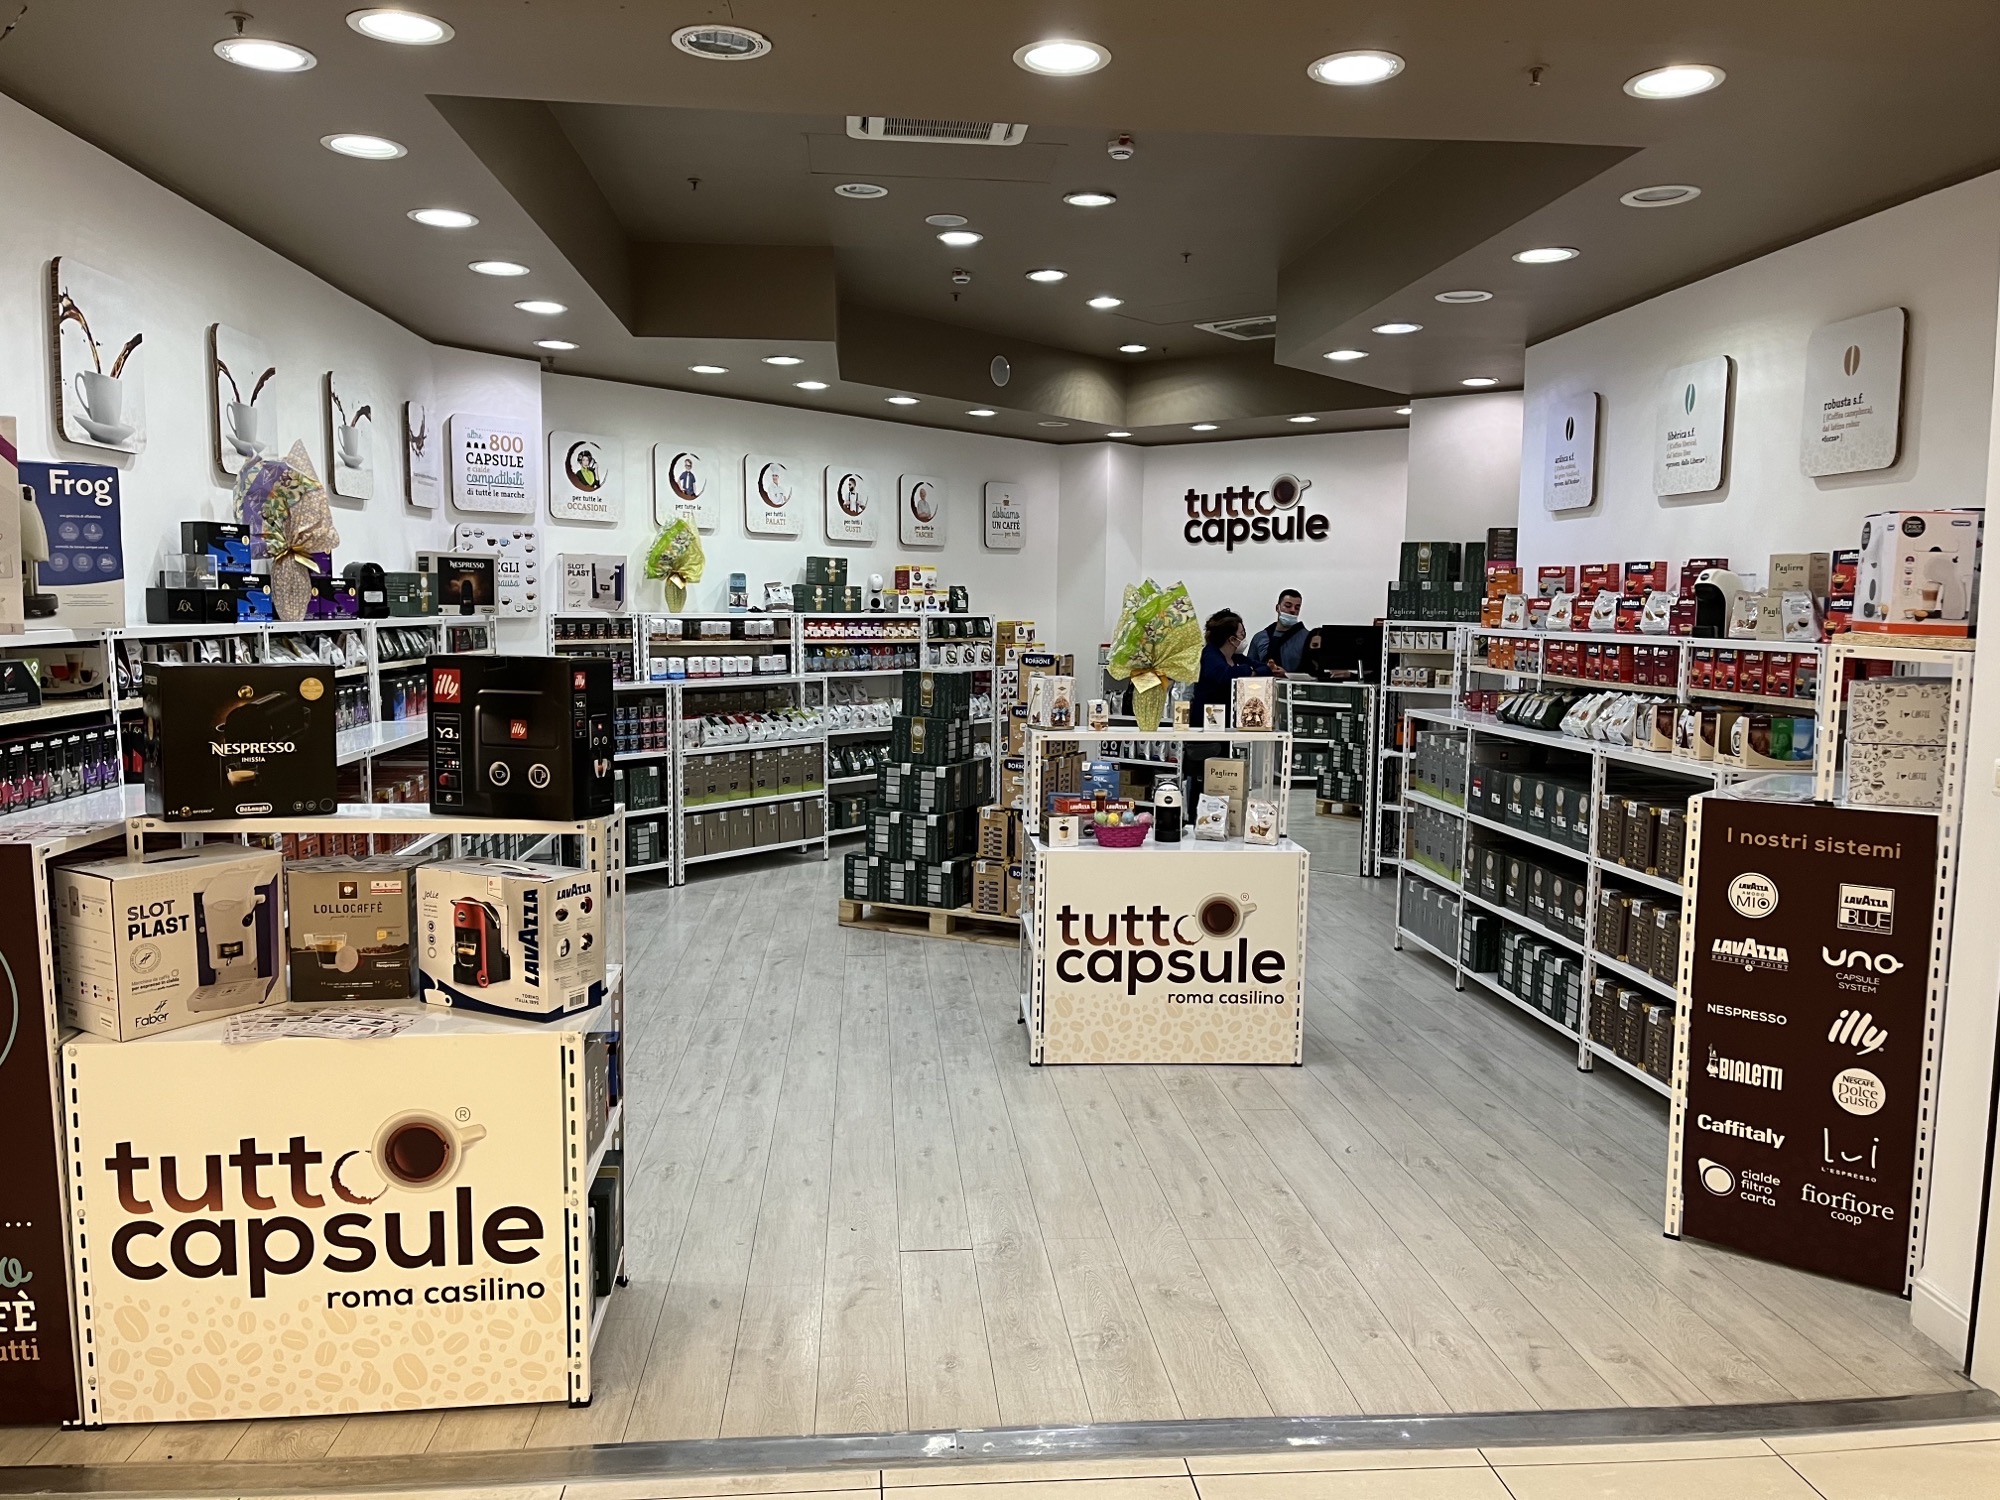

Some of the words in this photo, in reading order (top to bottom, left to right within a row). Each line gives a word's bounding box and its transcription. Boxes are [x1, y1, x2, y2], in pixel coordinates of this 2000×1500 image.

[1824, 397, 1851, 410] robusta
[490, 434, 524, 453] 800
[466, 452, 524, 468] CAPSULE
[49, 470, 113, 507] Frog
[466, 470, 525, 490] compatibili
[467, 488, 474, 496] di
[475, 489, 492, 497] tutte
[501, 490, 525, 499] marche
[567, 502, 608, 513] OCCASIONI
[992, 520, 1001, 529] UN
[1002, 520, 1021, 530] CAFFÈ
[1184, 506, 1329, 552] capsule
[449, 560, 485, 569] NESPRESSO
[435, 674, 459, 700] illy
[512, 722, 526, 736] illy
[209, 741, 296, 757] NESPRESSO
[1211, 768, 1238, 778] Pagliero
[1727, 827, 1732, 843] I
[1740, 832, 1808, 850] nostri
[1814, 837, 1901, 859] sistemi
[557, 883, 592, 901] LAVAZZA
[1739, 883, 1769, 892] LAVAZZA
[314, 901, 383, 914] LOLLOCAFFÈ
[1737, 895, 1770, 910] MIO
[1844, 895, 1889, 908] LAVAZZA
[128, 900, 176, 921] SLOT
[1844, 909, 1891, 929] BLUE
[128, 914, 190, 941] PLAST
[518, 888, 540, 988] LAVAZZA
[1712, 938, 1790, 963] LAVAZZA
[1056, 938, 1286, 996] capsule
[1822, 945, 1904, 975] uno
[1836, 972, 1880, 986] CAPSULE
[1838, 982, 1877, 994] SYSTEM
[1168, 992, 1214, 1004] roma
[1219, 991, 1285, 1005] casilino
[135, 1013, 169, 1028] Faber
[1707, 1003, 1788, 1026] NESPRESSO
[1828, 1009, 1889, 1056] illy
[1842, 1075, 1876, 1088] NESCAFÉ
[1838, 1083, 1878, 1100] Dolce
[1838, 1093, 1878, 1110] Gusto
[1697, 1114, 1786, 1149] Caffitaly
[105, 1136, 390, 1215] tutto
[1741, 1170, 1781, 1187] cialde
[1741, 1179, 1773, 1196] filtro
[1740, 1191, 1777, 1207] carta
[1800, 1183, 1895, 1221] fiorfiore
[1830, 1210, 1862, 1227] coop
[111, 1186, 545, 1299] capsule
[327, 1286, 414, 1309] roma
[424, 1278, 546, 1304] casilino
